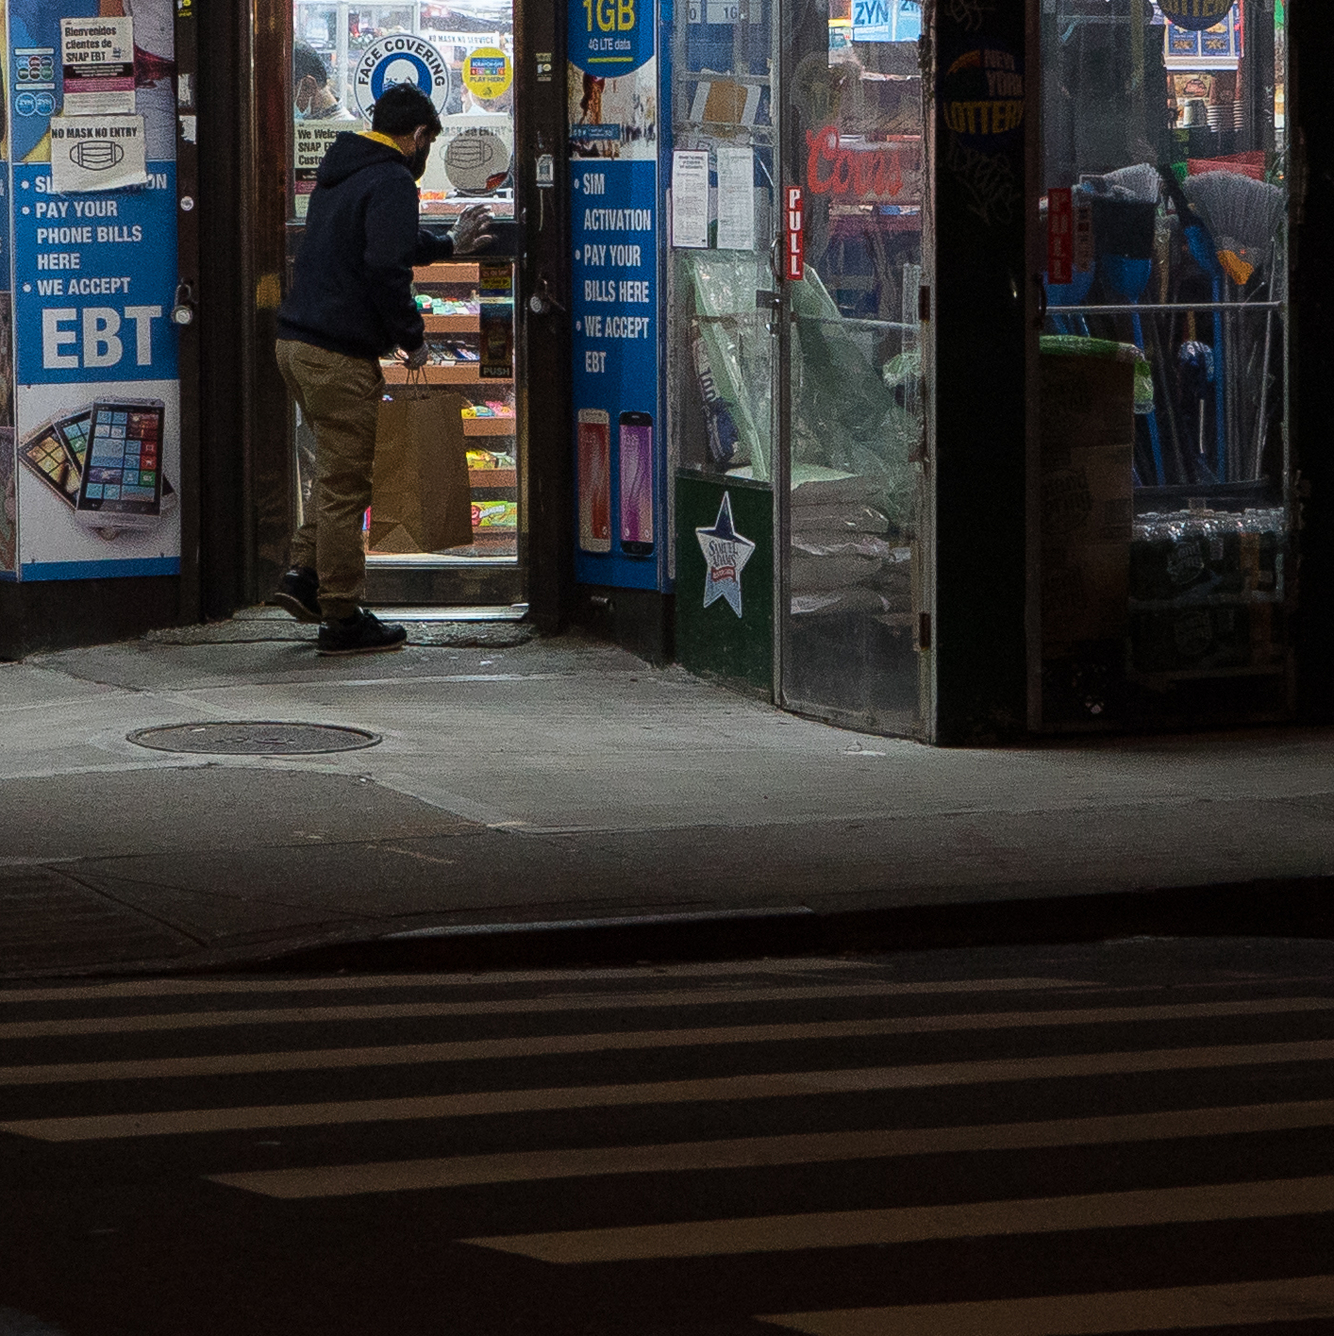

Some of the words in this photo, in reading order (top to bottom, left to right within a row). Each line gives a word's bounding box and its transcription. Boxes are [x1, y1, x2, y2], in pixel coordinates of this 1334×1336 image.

[854, 1, 891, 25] ZYN
[64, 25, 117, 38] Bienvenidos
[438, 35, 456, 43] MASK
[466, 36, 495, 45] SERVICE
[65, 39, 100, 50] clientes
[101, 38, 113, 49] de
[614, 37, 632, 50] data
[65, 51, 90, 63] SNAP
[90, 51, 107, 62] EBT
[357, 51, 384, 86] FACE
[383, 38, 446, 88] COVERING
[943, 99, 1024, 135] LOTTERY
[51, 128, 65, 139] NO
[67, 127, 94, 139] MASK
[94, 127, 108, 138] NO
[109, 126, 138, 138] ENTRY
[297, 129, 311, 140] We
[297, 141, 322, 152] SNAP
[583, 172, 605, 195] SIM
[35, 201, 69, 219] PAY
[74, 200, 118, 217] YOUR
[583, 208, 652, 232] ACTIVATION
[37, 227, 93, 245] PHONE
[96, 224, 143, 242] BILLS
[788, 187, 802, 278] PULL
[37, 252, 81, 271] HERE
[583, 244, 607, 267] PAY
[608, 243, 642, 267] YOUR
[37, 278, 64, 296] WE
[67, 276, 131, 295] ACCEPT
[584, 281, 617, 304] BILLS
[619, 280, 650, 303] HERE
[41, 304, 163, 370] EBT
[583, 315, 603, 339] WE
[604, 316, 649, 340] ACCEPT
[483, 366, 510, 376] PUSH
[584, 351, 607, 374] EBT
